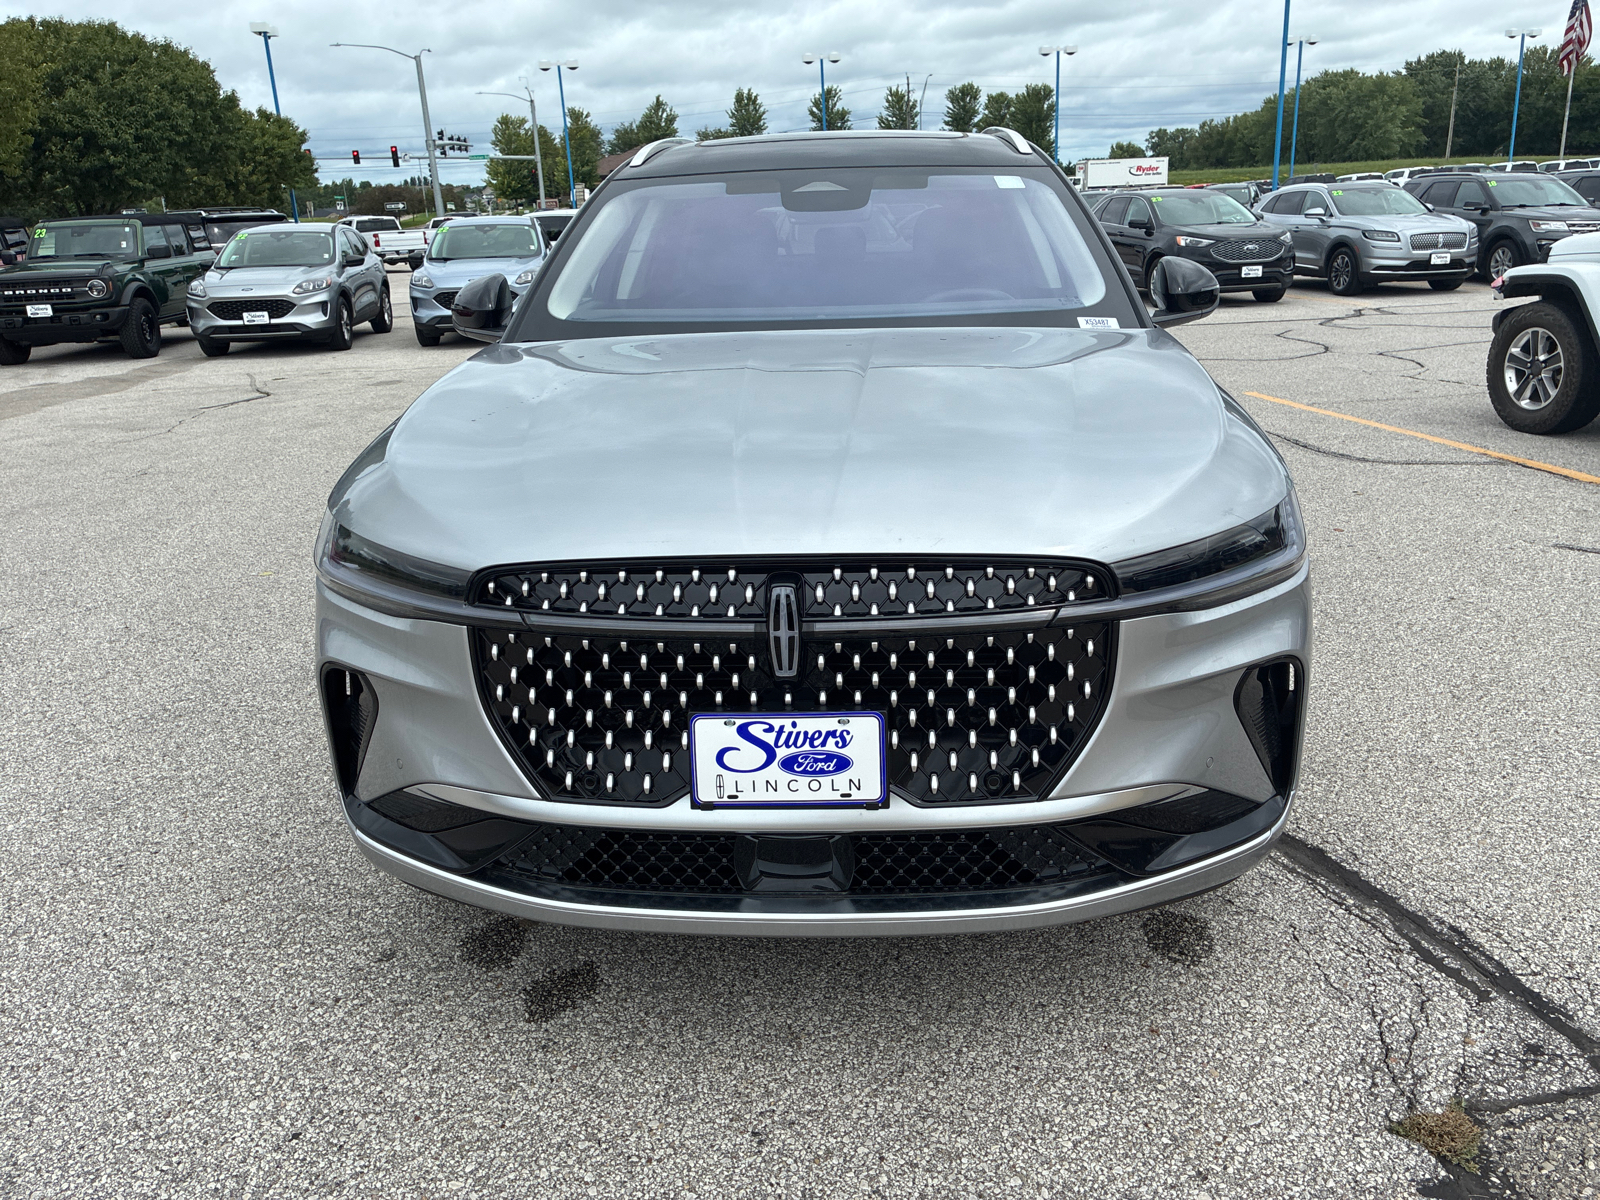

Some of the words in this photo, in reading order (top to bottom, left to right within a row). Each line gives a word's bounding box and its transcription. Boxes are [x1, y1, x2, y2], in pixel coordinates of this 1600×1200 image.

[1135, 165, 1160, 173] Ryder
[34, 228, 47, 239] 23
[4, 287, 72, 295] BRONCO
[1084, 318, 1109, 326] X53487
[715, 720, 853, 773] Stivers
[793, 754, 837, 772] Ford
[735, 778, 861, 793] LINCOLN
